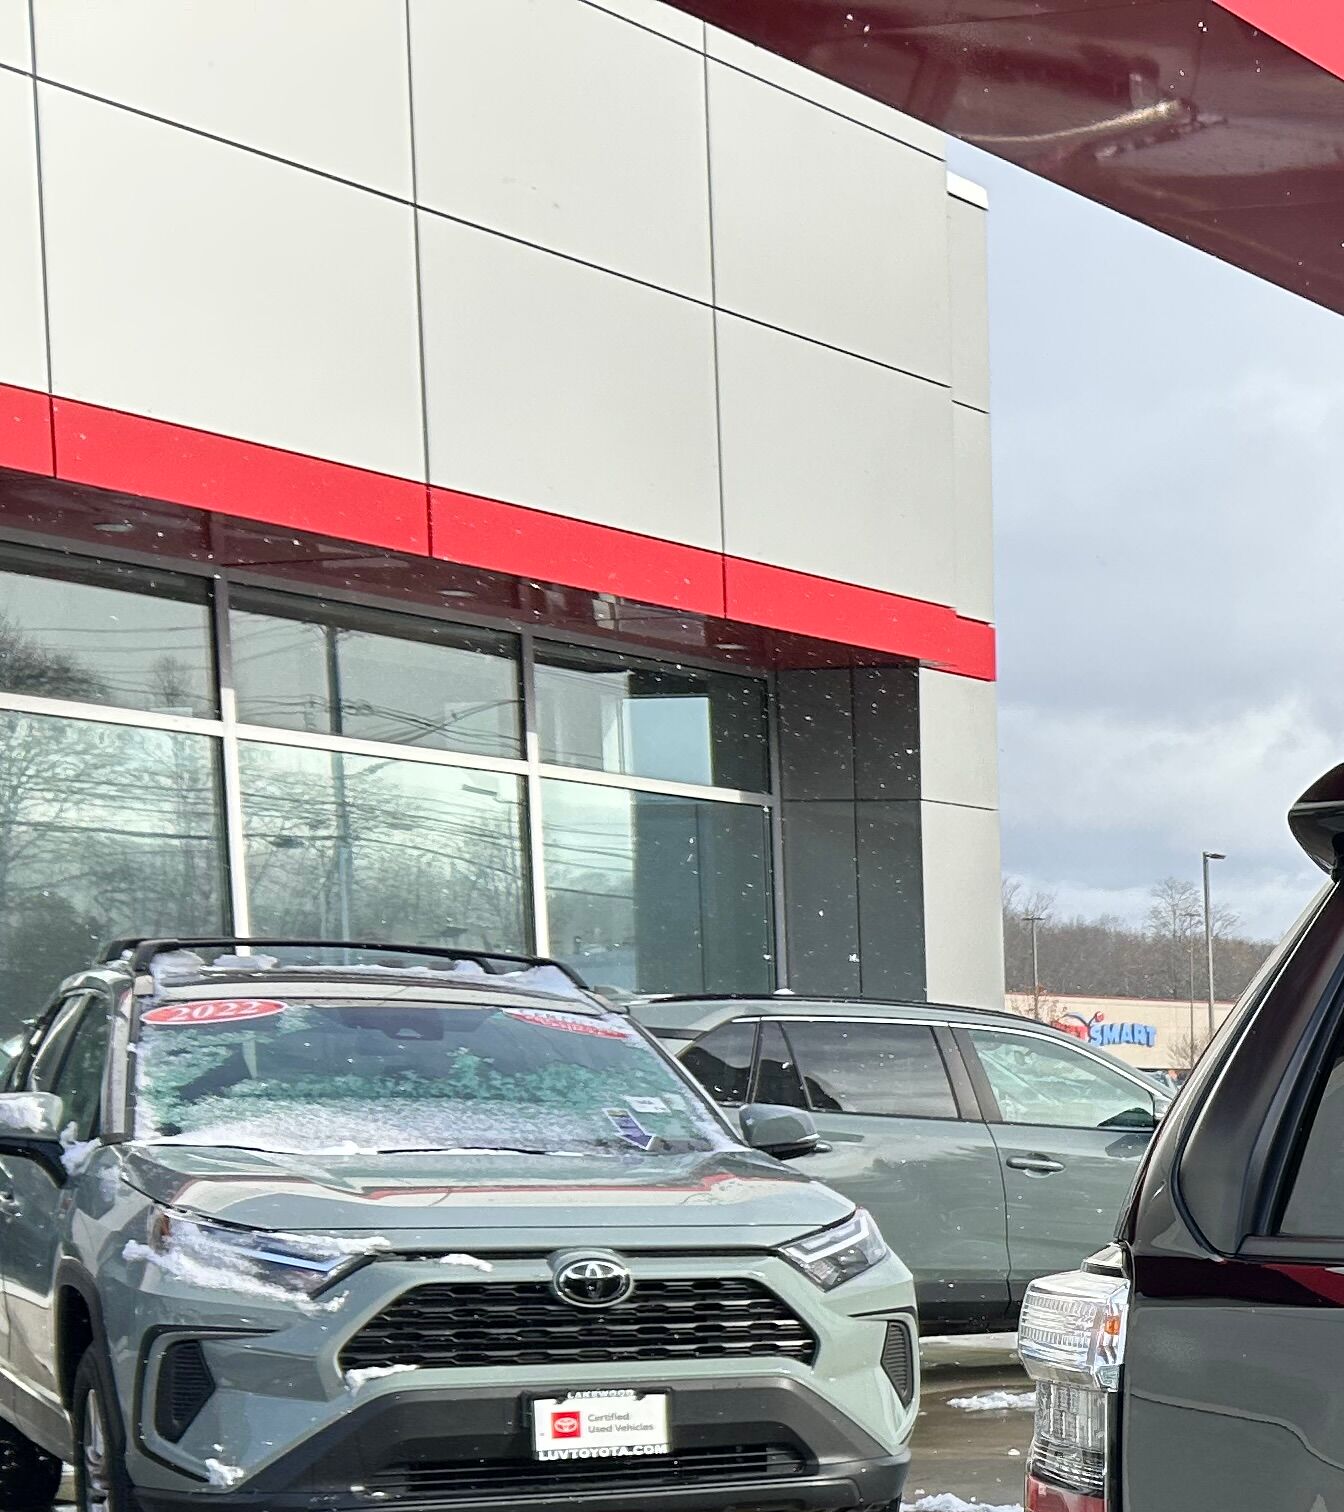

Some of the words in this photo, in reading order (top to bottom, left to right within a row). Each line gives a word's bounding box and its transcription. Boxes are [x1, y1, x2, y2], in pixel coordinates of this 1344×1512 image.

[166, 1000, 262, 1022] 2022
[567, 1389, 637, 1400] LAKEWOOD
[587, 1412, 630, 1422] Certified
[588, 1424, 613, 1433] Used
[615, 1422, 654, 1432] Vehicles
[538, 1444, 669, 1461] LUVTOYOTA.COM
